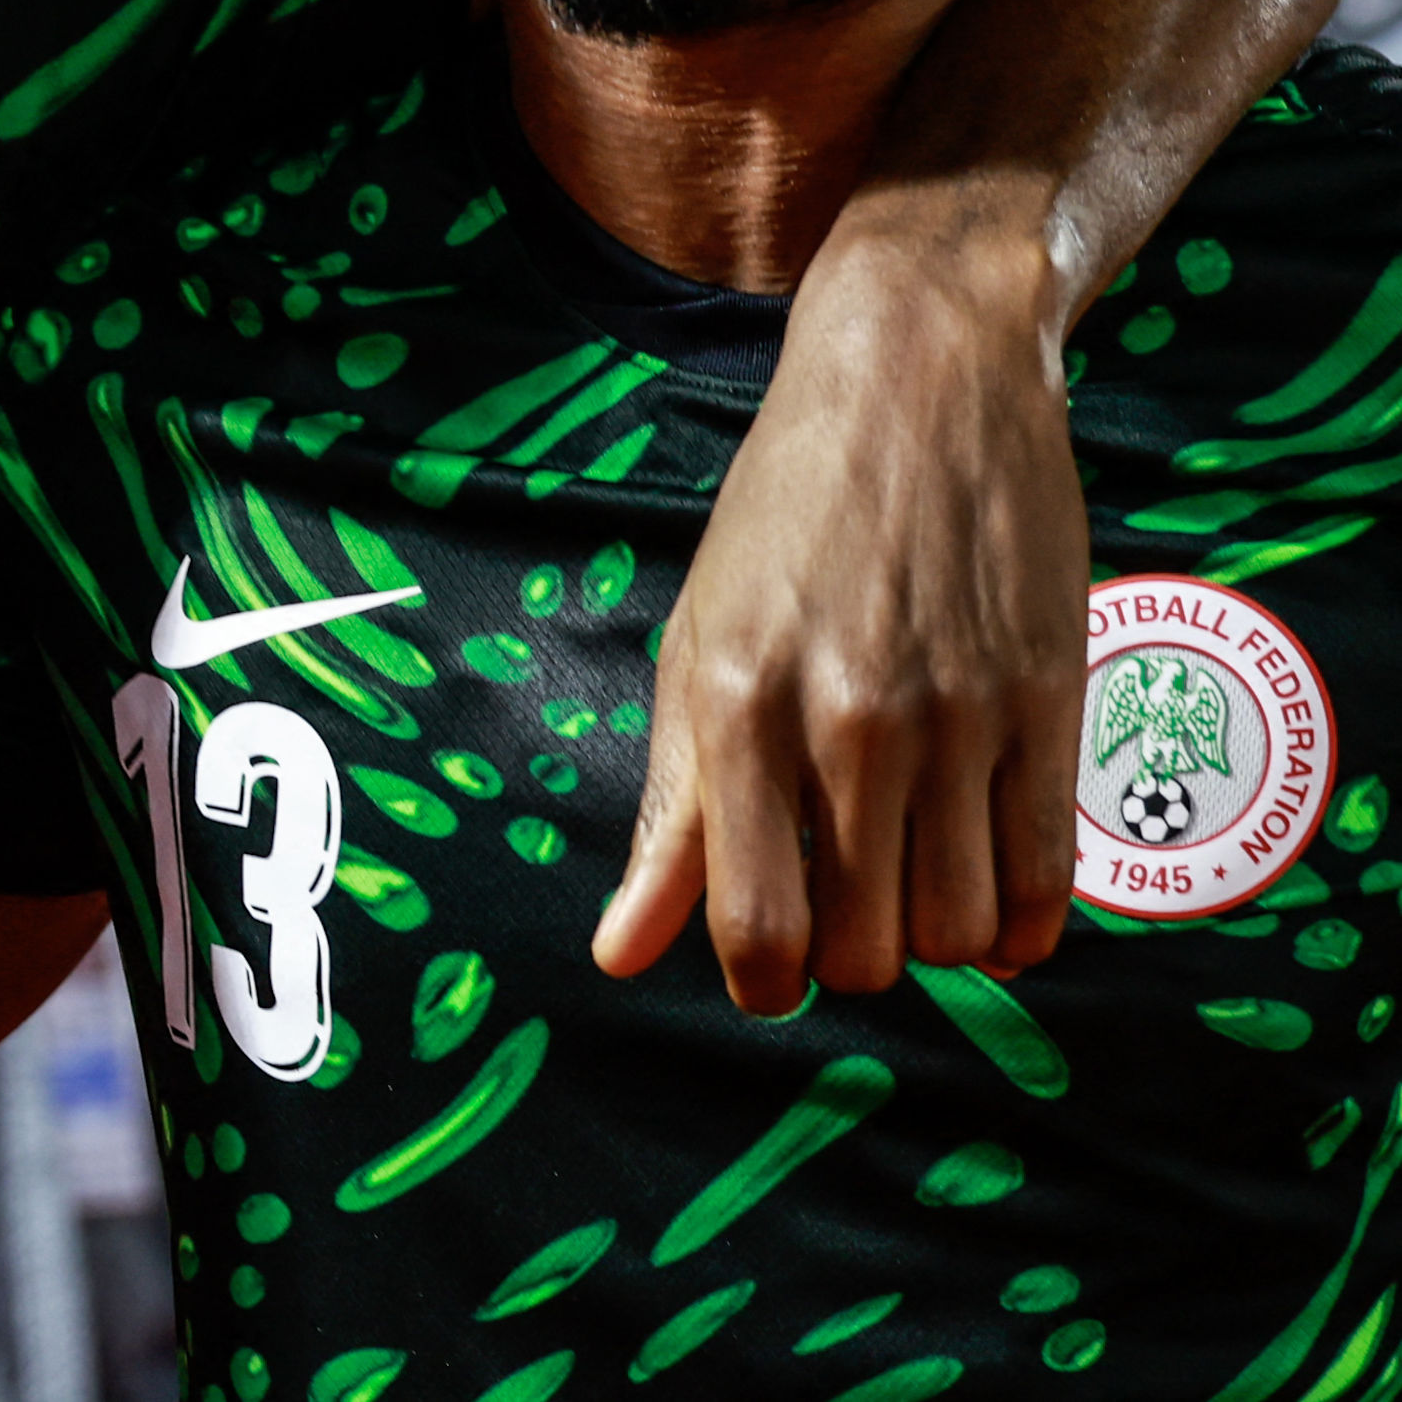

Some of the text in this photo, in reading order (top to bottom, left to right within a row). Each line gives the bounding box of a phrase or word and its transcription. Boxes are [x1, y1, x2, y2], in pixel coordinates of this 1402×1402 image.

[1087, 594, 1315, 866] OTBALL FEDERATION
[111, 671, 343, 1083] 13
[1108, 857, 1193, 895] 1945
